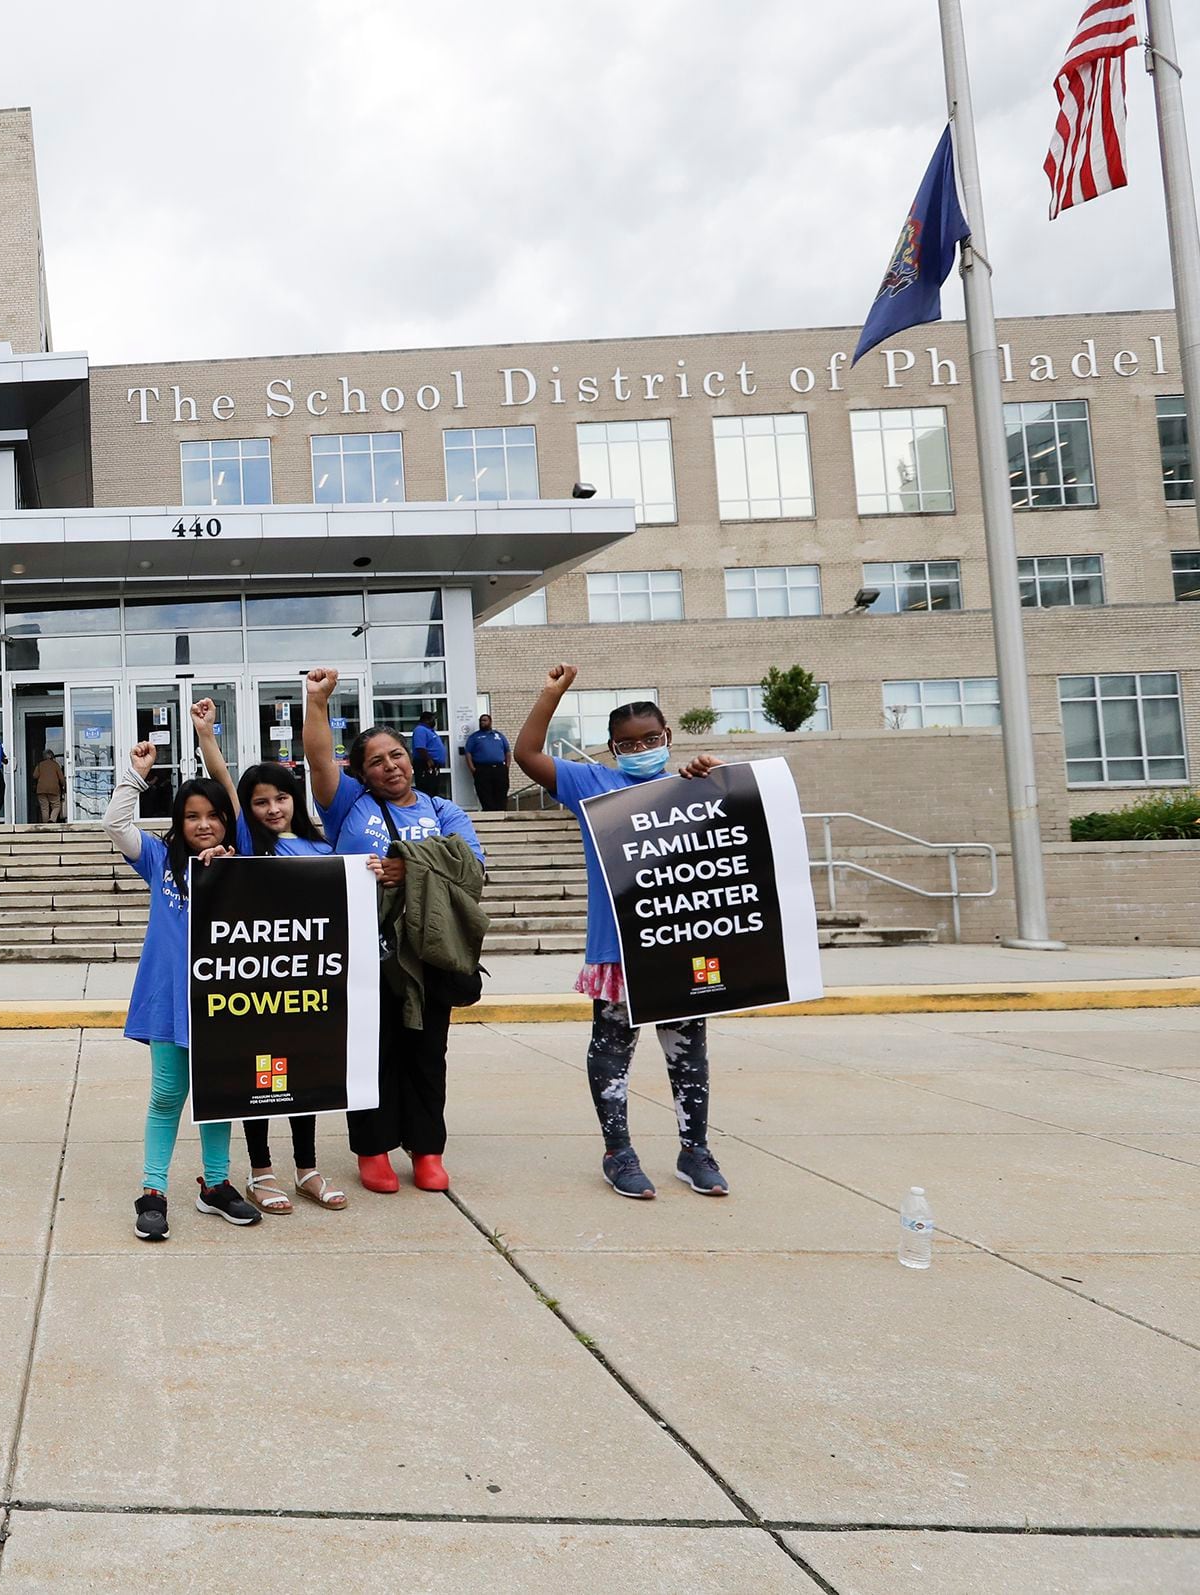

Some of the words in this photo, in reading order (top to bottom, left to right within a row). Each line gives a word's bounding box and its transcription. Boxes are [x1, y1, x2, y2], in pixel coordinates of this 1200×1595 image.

[127, 385, 236, 424] The
[266, 370, 468, 418] School
[499, 360, 757, 406] District
[790, 352, 847, 393] of
[880, 336, 1169, 389] Phladel
[171, 517, 222, 538] 440
[631, 799, 727, 831] BLACK
[622, 826, 748, 861] FAMILIES
[635, 855, 749, 888] CHOOSE
[635, 884, 759, 918] CHARTER
[211, 918, 330, 944] PARENT
[640, 912, 763, 948] SCHOOLS
[192, 955, 308, 981] CHOICE
[318, 953, 343, 976] IS
[207, 989, 328, 1017] POWER!
